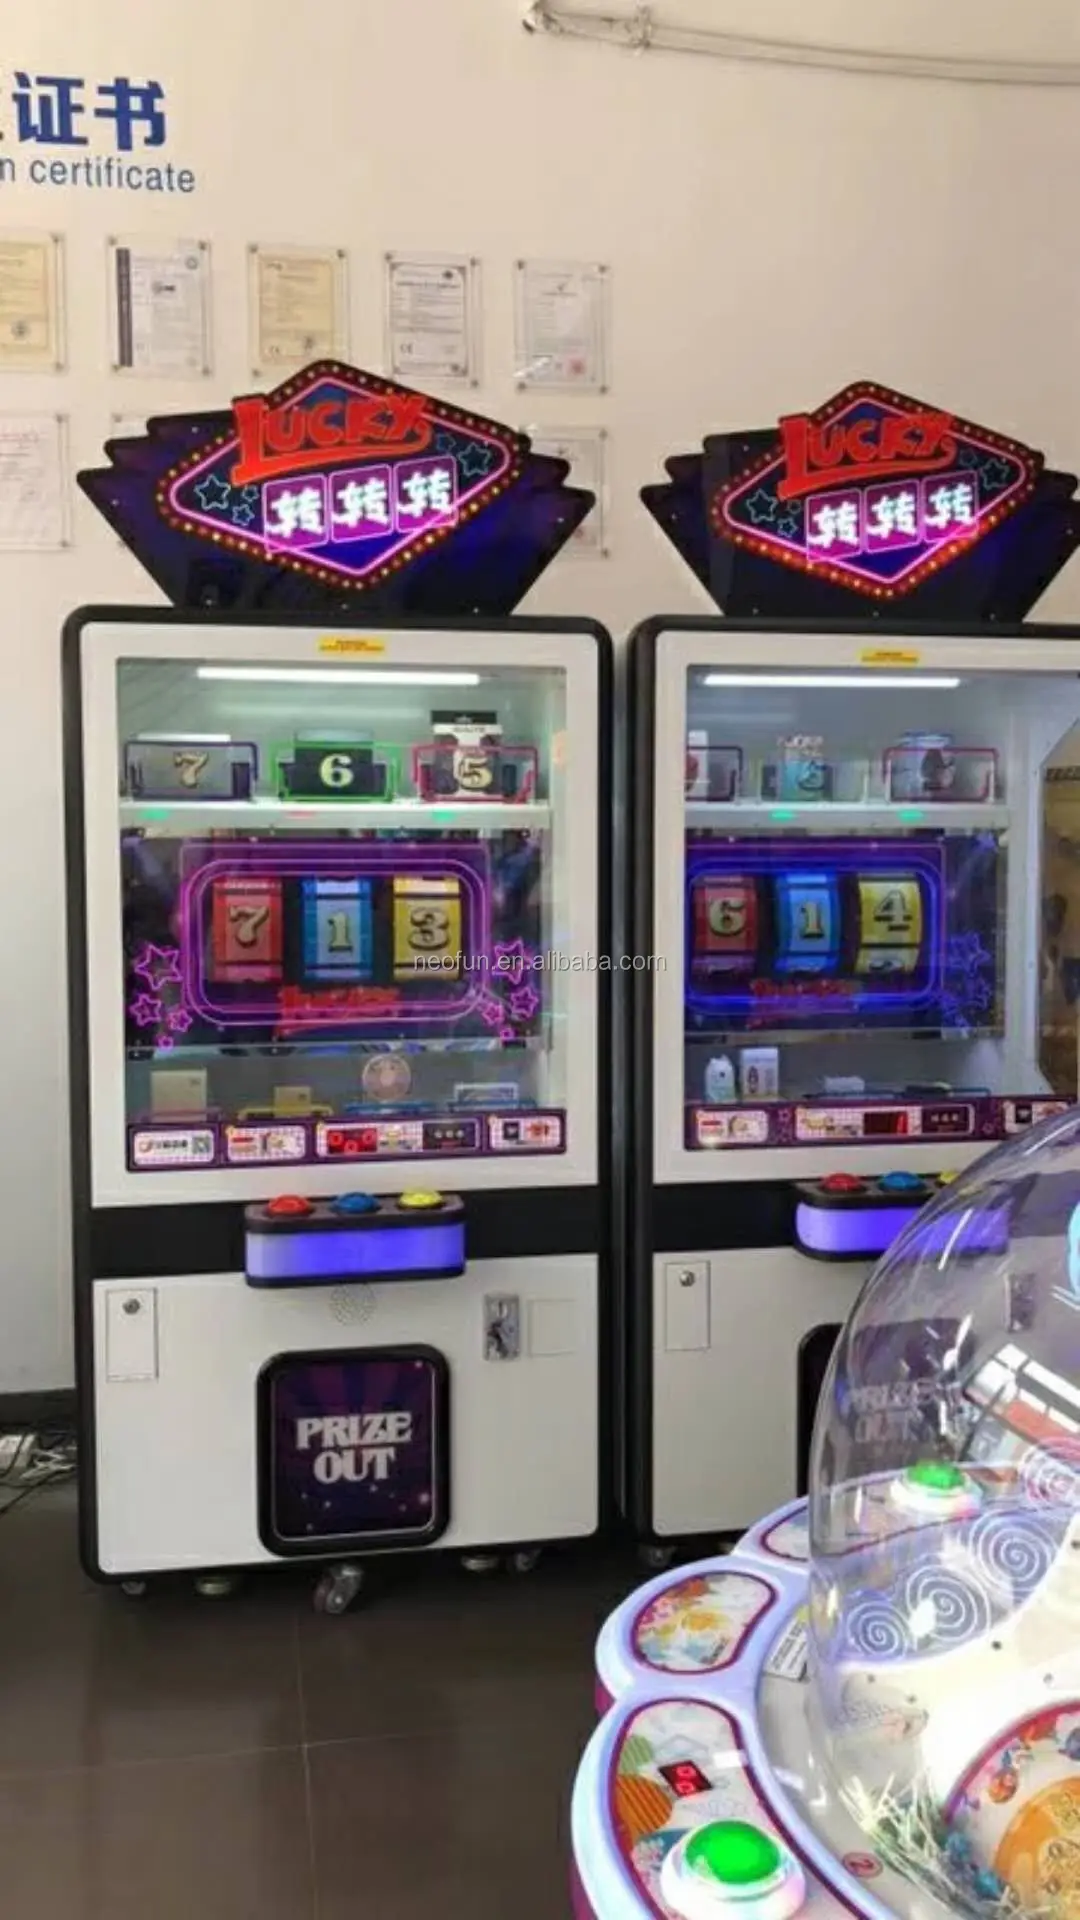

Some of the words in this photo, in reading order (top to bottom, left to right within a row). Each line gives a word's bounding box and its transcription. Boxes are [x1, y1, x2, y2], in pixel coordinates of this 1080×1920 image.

[0, 71, 166, 151] 证书
[29, 155, 196, 194] certificate
[231, 396, 432, 487] LUCKY
[777, 412, 957, 500] LUCKY
[173, 751, 209, 789] 7
[319, 752, 354, 788] 6
[459, 756, 493, 791] 5
[229, 904, 269, 948] 7
[327, 910, 353, 952] 1
[408, 906, 449, 950] 3
[800, 901, 825, 938] 1
[871, 889, 912, 932] 4
[296, 1411, 413, 1449] PRIZE
[313, 1447, 396, 1484] OUT
